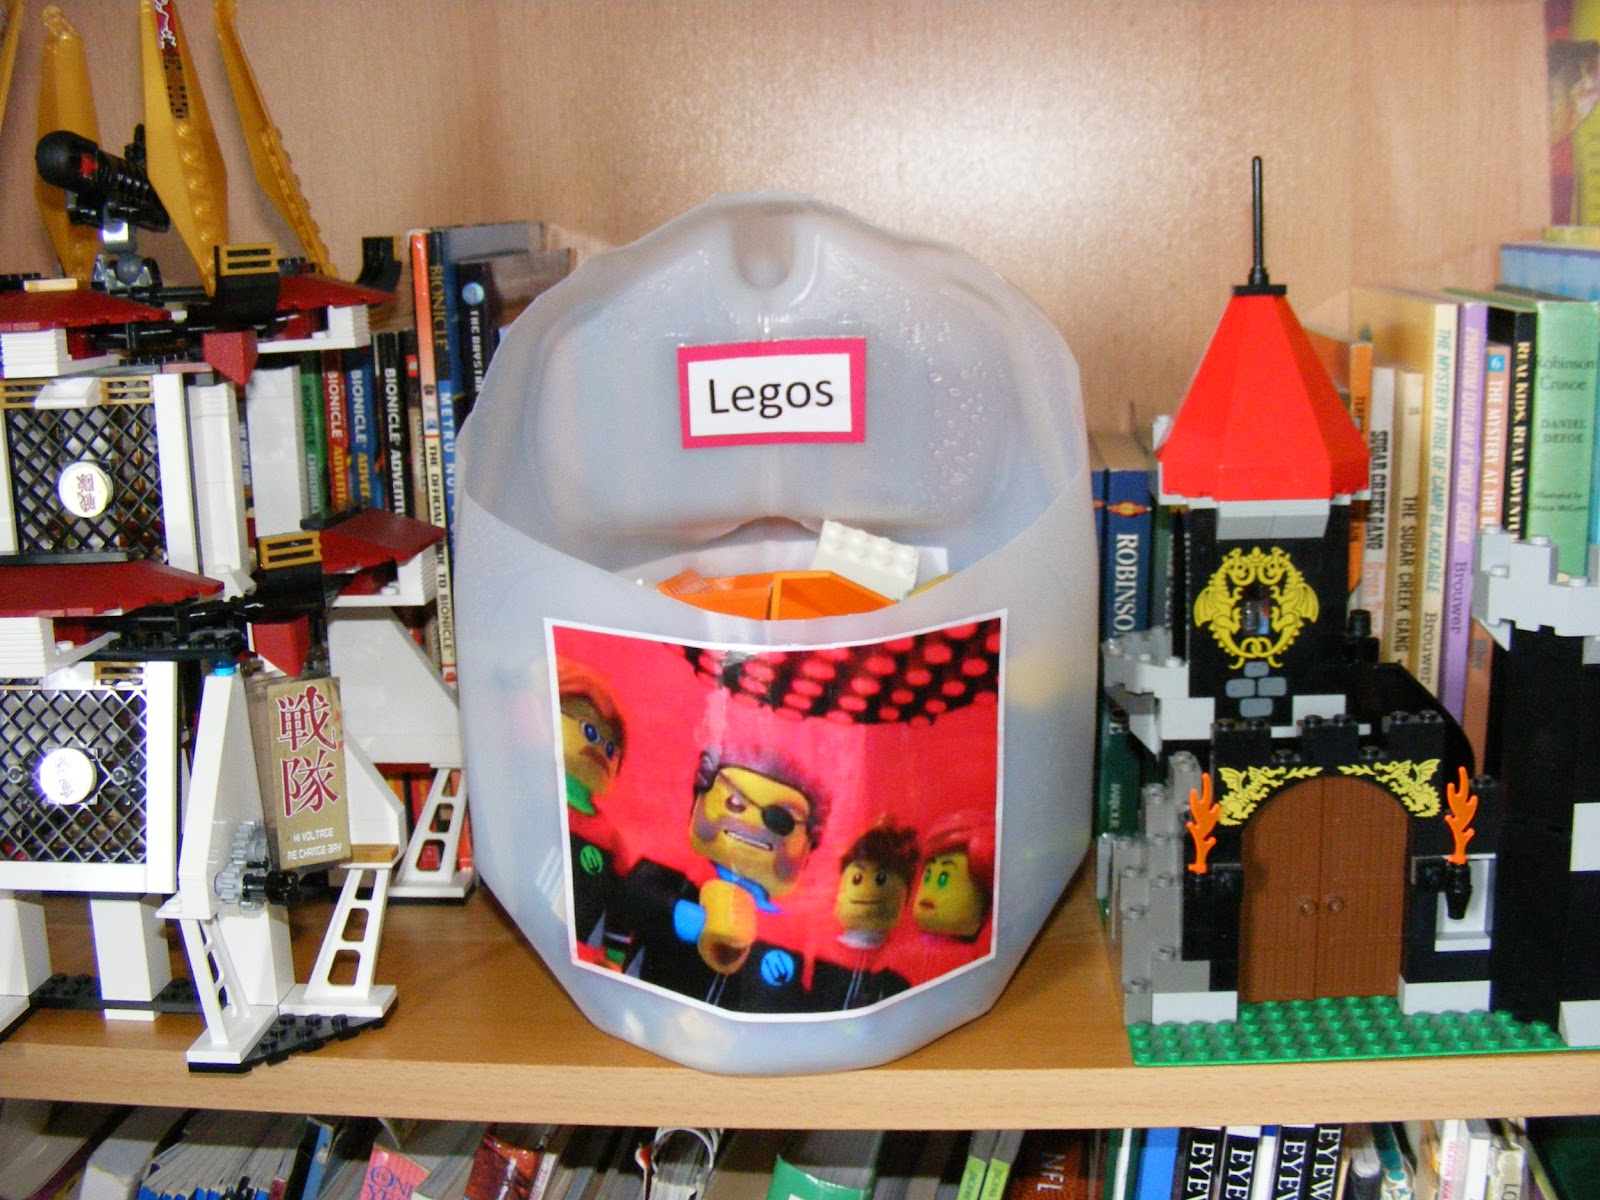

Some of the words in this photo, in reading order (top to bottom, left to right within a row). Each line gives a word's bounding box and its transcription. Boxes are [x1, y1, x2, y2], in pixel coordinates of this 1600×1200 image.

[430, 265, 448, 348] BIONICLE
[1436, 329, 1451, 350] THE
[709, 379, 834, 419] Legos
[1434, 354, 1450, 411] MYSTERY
[1488, 380, 1504, 404] THE
[327, 370, 343, 438] BIONICLE
[350, 369, 367, 447] BIONICLE
[384, 367, 400, 446] BIONICLE
[440, 392, 454, 452] METRU
[1370, 430, 1389, 470] SUGAR
[1432, 416, 1448, 451] TRIBE
[1484, 408, 1502, 464] MYSTERY
[429, 445, 440, 468] THE
[1431, 455, 1446, 472] OF
[1368, 474, 1387, 515] CREEK
[1430, 475, 1445, 512] CAMP
[1484, 469, 1499, 485] AT
[431, 474, 443, 524] OFFICIAL
[1402, 495, 1418, 519] THE
[1482, 490, 1497, 512] THE
[1366, 516, 1385, 550] GANG
[1399, 526, 1416, 567] SUGAR
[438, 573, 447, 588] TO
[1397, 573, 1413, 612] CREEK
[1450, 560, 1467, 635] Brouwer
[439, 594, 452, 650] BIONICLE
[1394, 618, 1410, 653] GANG
[1419, 612, 1438, 685] Brouwer
[275, 684, 340, 818] 戦隊
[301, 827, 335, 842] VOLTAGE
[1037, 1153, 1066, 1191] NFL
[1225, 1147, 1255, 1200] EYE
